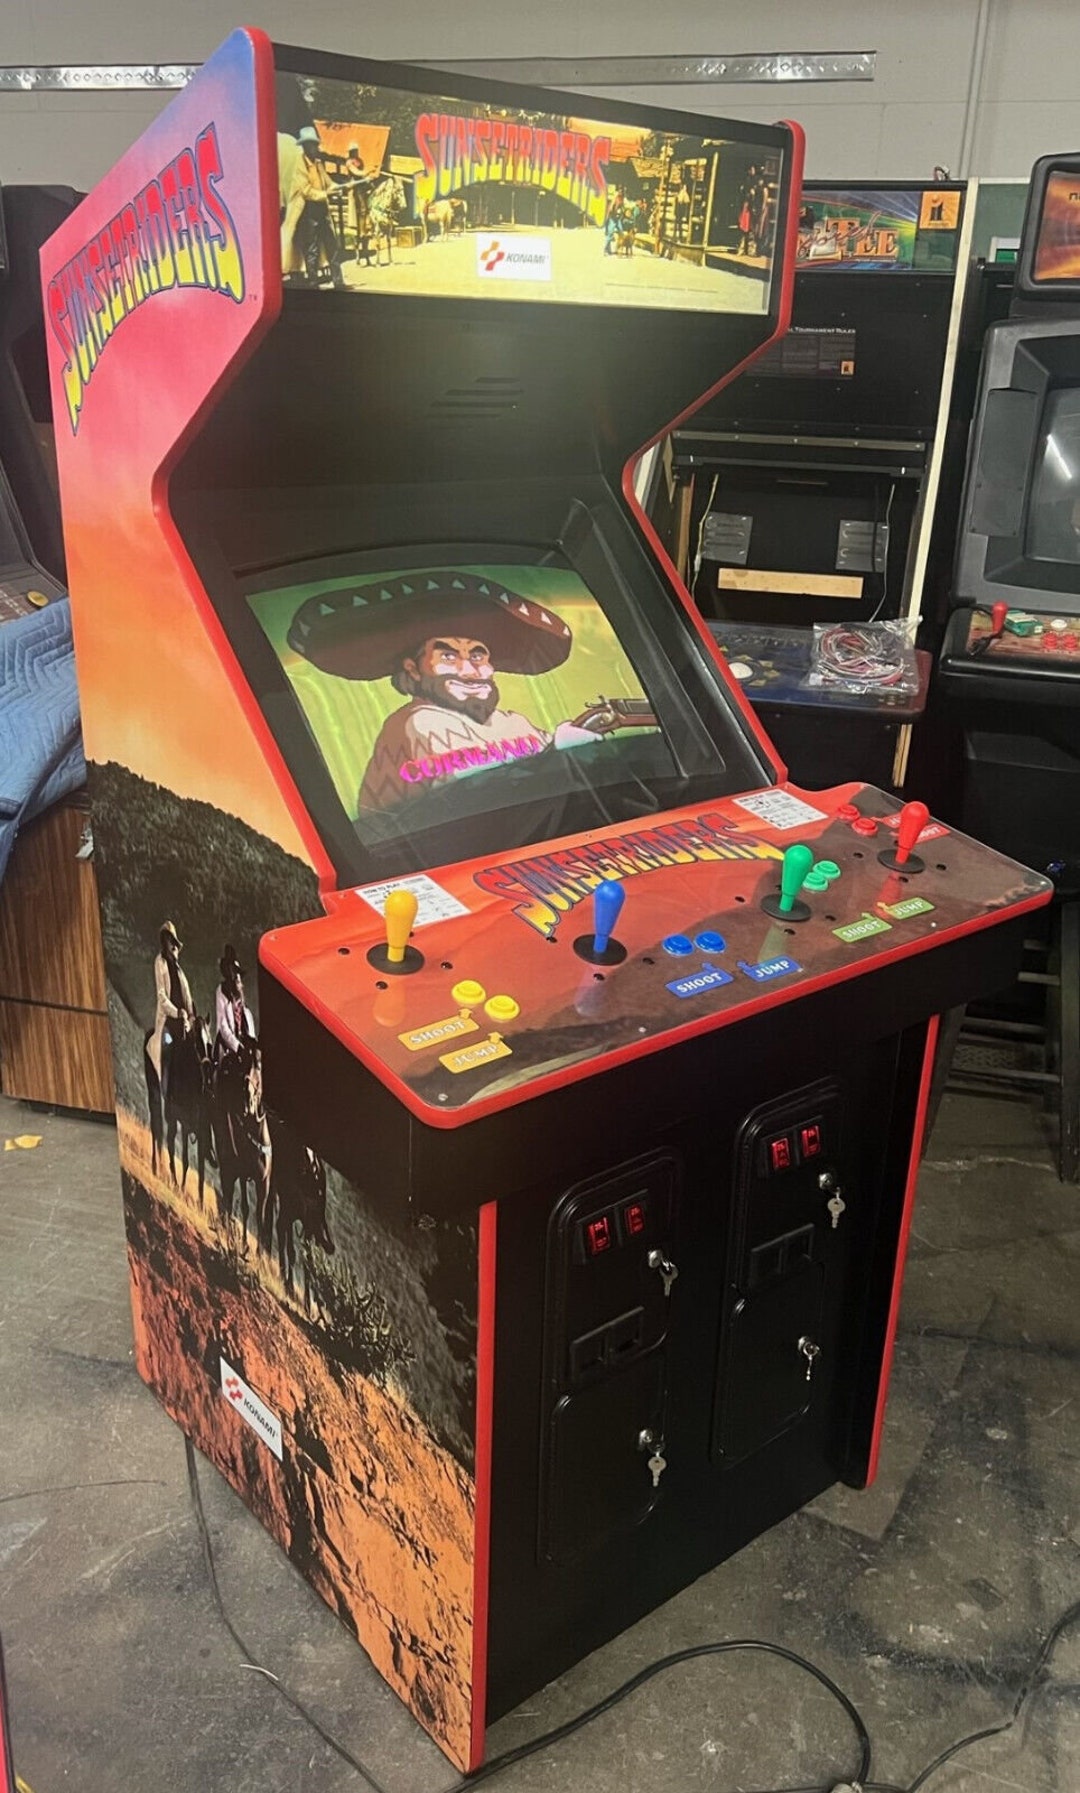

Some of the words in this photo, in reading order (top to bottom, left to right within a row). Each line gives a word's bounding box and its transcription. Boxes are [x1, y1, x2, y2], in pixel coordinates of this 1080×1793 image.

[506, 251, 548, 265] KONAMI
[894, 901, 924, 916] JUMP
[842, 920, 881, 938] SHOOT
[755, 960, 790, 978] JUMP
[676, 972, 722, 993] SHOOT
[410, 1020, 466, 1044] SHOOT
[454, 1044, 498, 1067] JUMP
[243, 1398, 277, 1438] KONAMI
